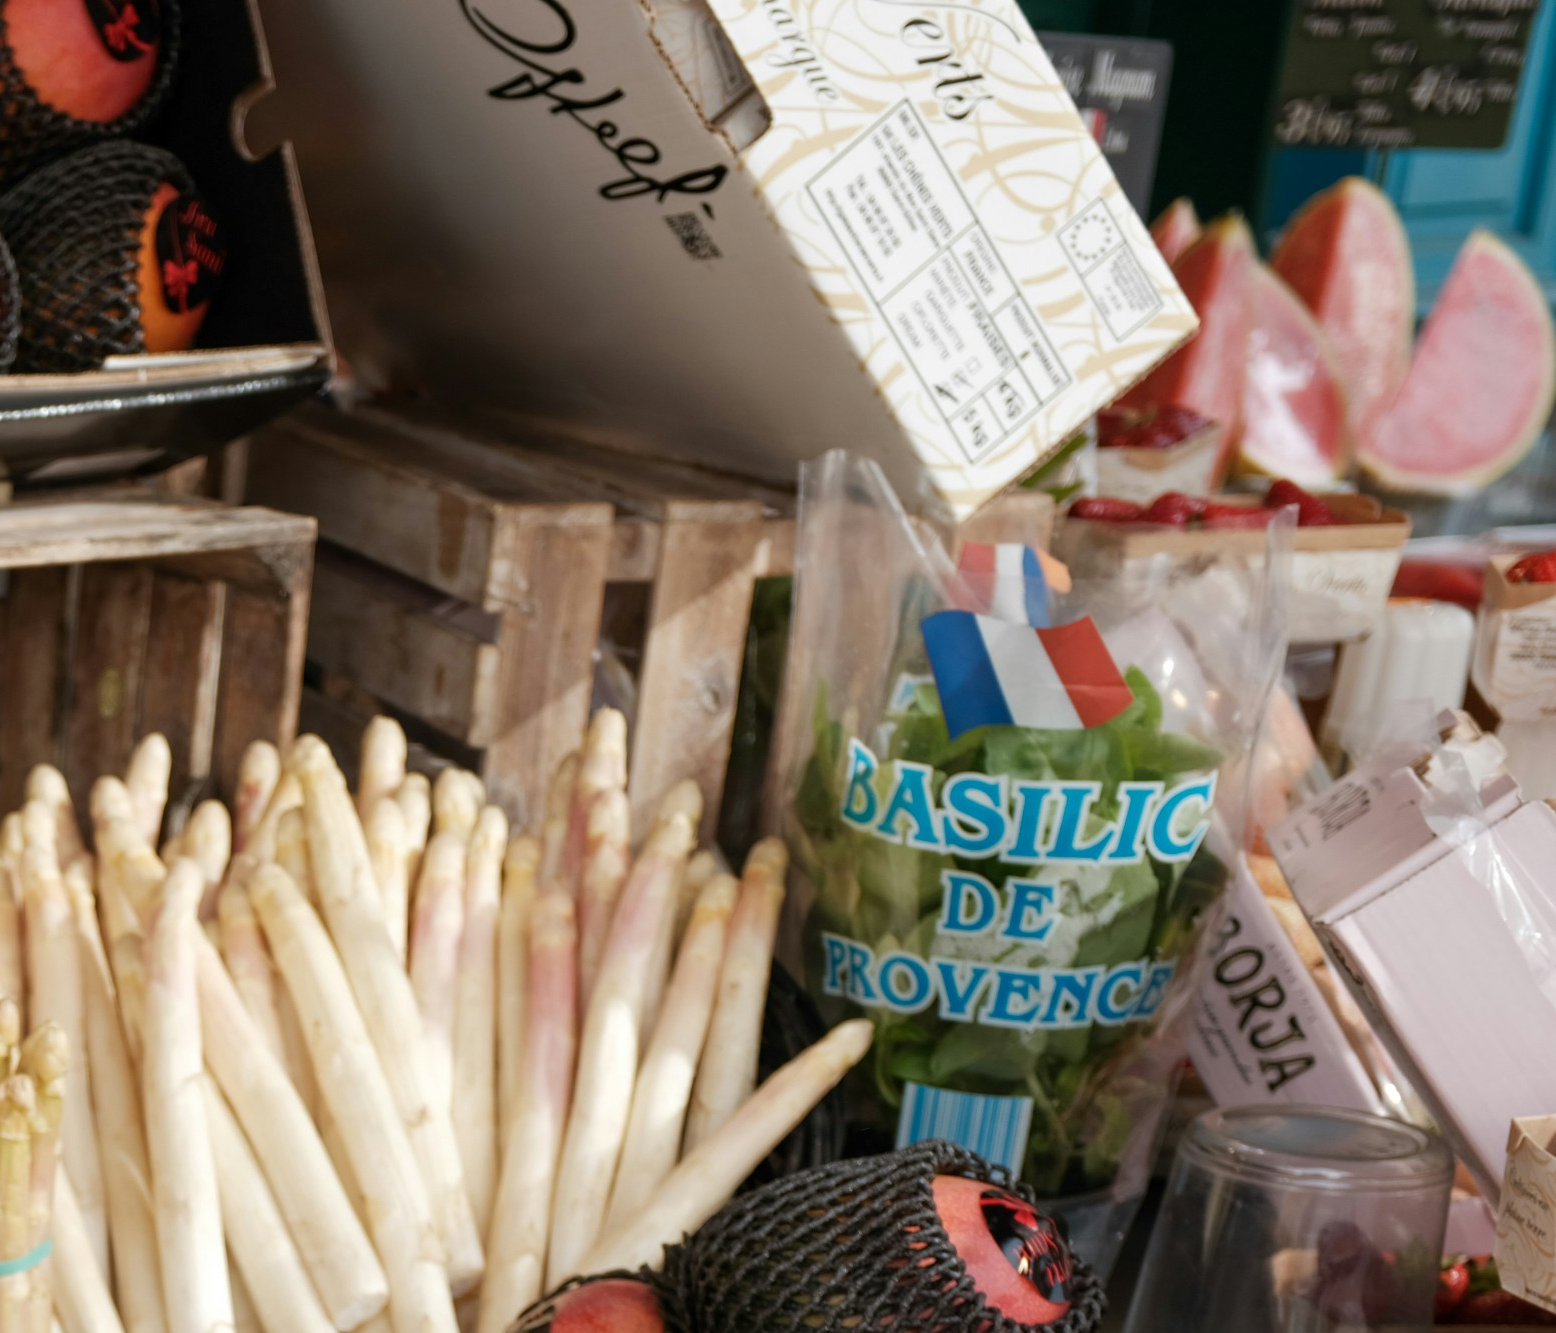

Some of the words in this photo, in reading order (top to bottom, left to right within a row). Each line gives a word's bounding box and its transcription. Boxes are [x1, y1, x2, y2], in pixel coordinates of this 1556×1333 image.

[840, 737, 1218, 866] BASILIC
[936, 869, 1061, 945] DE
[821, 934, 1177, 1030] PROVENCE
